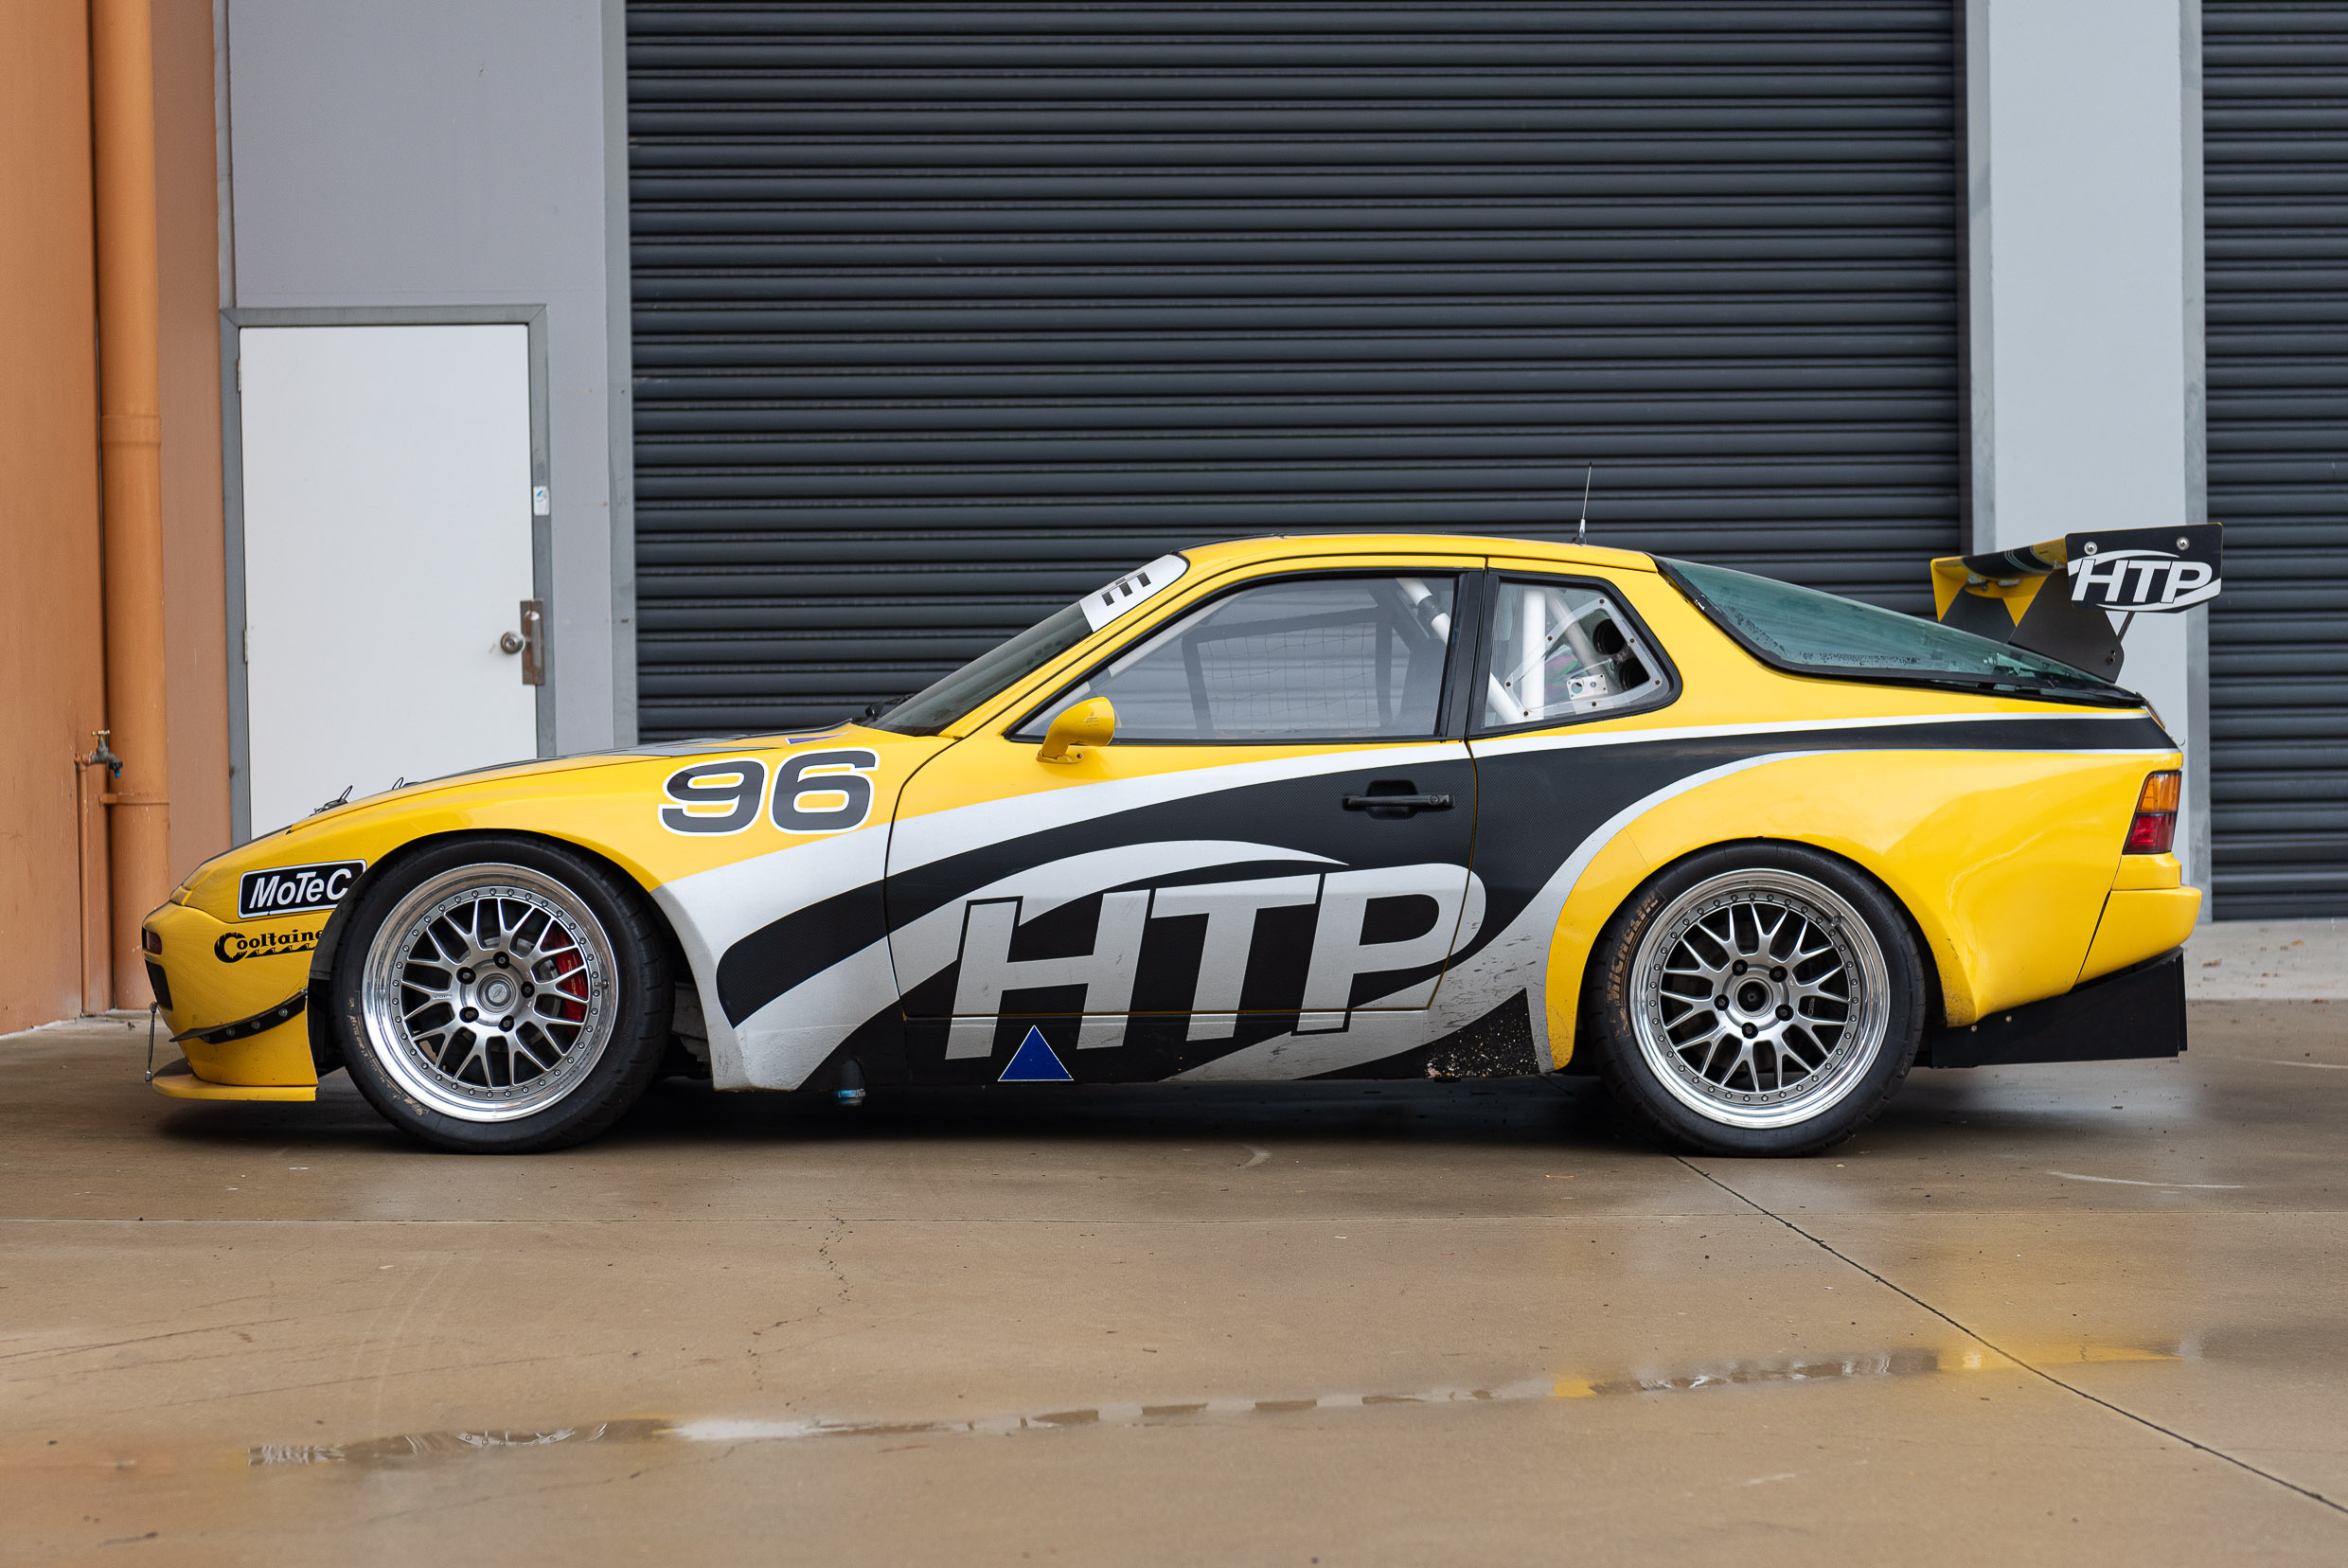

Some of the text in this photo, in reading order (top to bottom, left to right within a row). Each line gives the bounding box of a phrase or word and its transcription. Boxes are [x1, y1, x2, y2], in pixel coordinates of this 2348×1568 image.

[2072, 559, 2214, 604] HTP
[658, 747, 880, 837] 96
[249, 868, 352, 909] MoTeC
[945, 863, 1486, 1060] HTP
